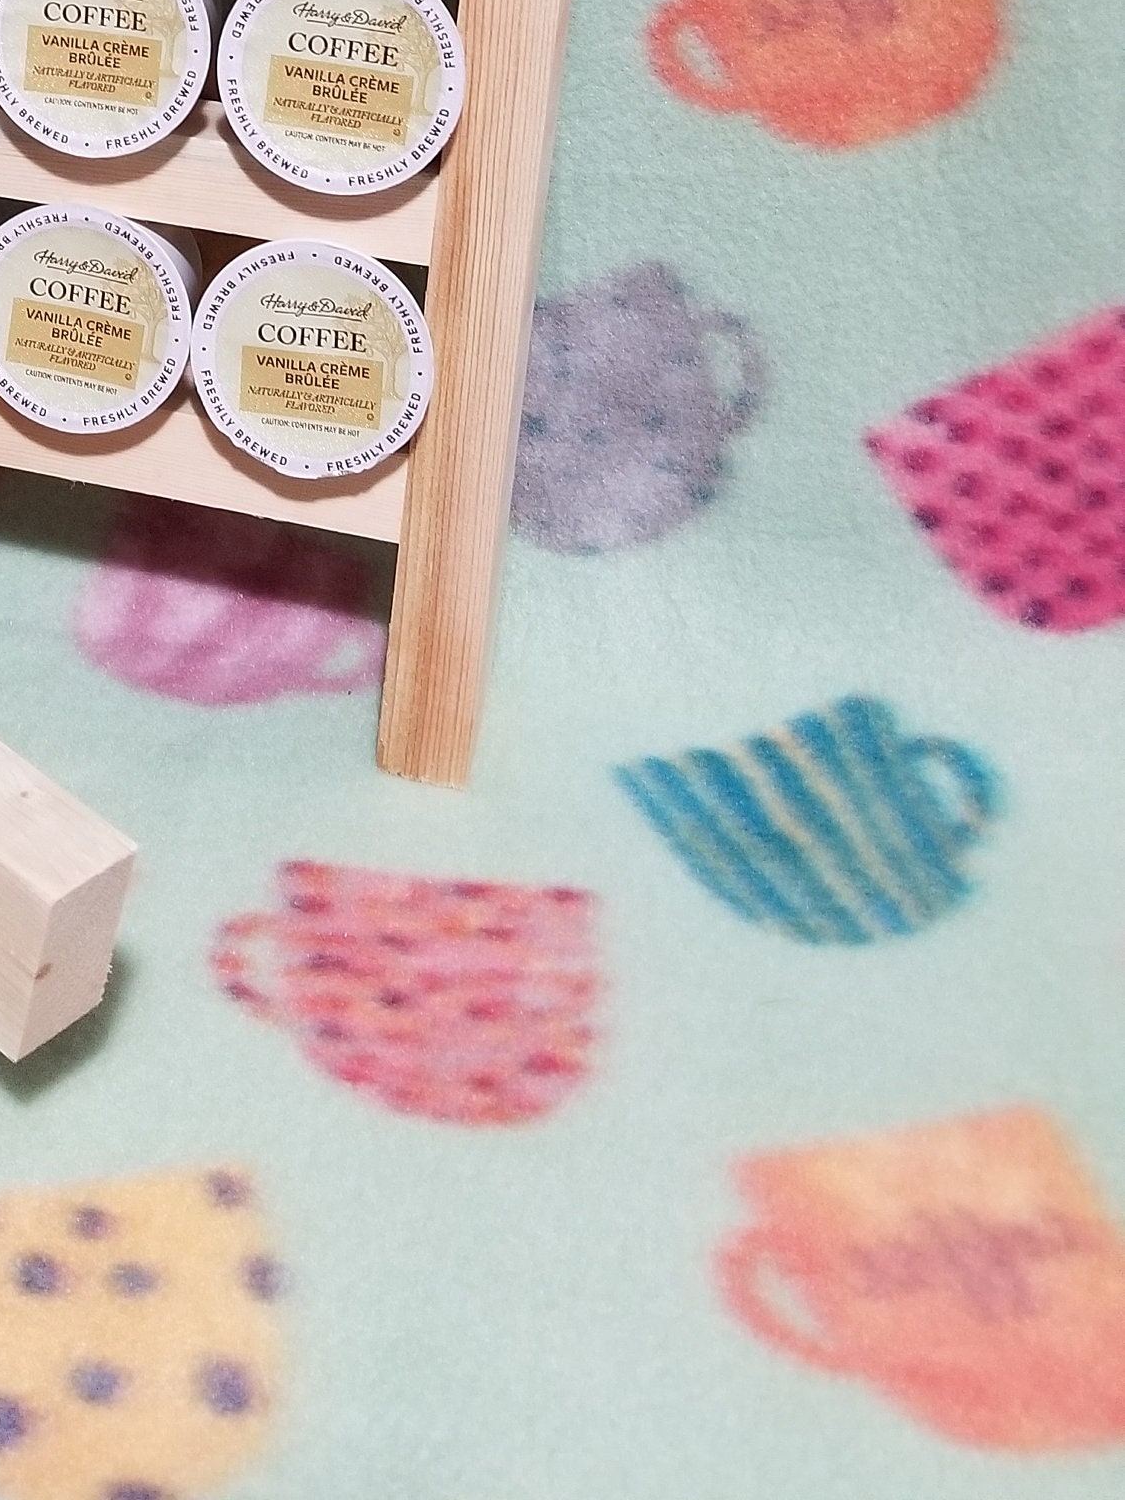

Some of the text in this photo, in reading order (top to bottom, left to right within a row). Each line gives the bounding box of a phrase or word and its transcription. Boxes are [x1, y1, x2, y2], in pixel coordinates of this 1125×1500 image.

[43, 1, 148, 32] COFFEE
[41, 33, 150, 58] VANILLA CRÈME
[68, 51, 122, 69] BRÛLÉE
[288, 32, 399, 67] COFFEE
[284, 64, 400, 94] VANILLA CRÈME
[312, 84, 369, 104] BRÛLÉE
[105, 70, 196, 150] FRESHLY BREWED
[226, 79, 309, 179] FRESHLY BREWED
[29, 277, 131, 315] COFFEE
[26, 307, 132, 341] VANILLA CRÈME
[51, 327, 104, 349] BRÛLÉE
[257, 322, 367, 353] COFFEE
[49, 354, 97, 371] FLAVORED
[256, 355, 370, 379] VANILLA CRÈME
[83, 358, 176, 427] FRESHLY BREWED
[285, 372, 340, 390] BRÛLÉE
[201, 370, 287, 466] FRESHLY BREWED
